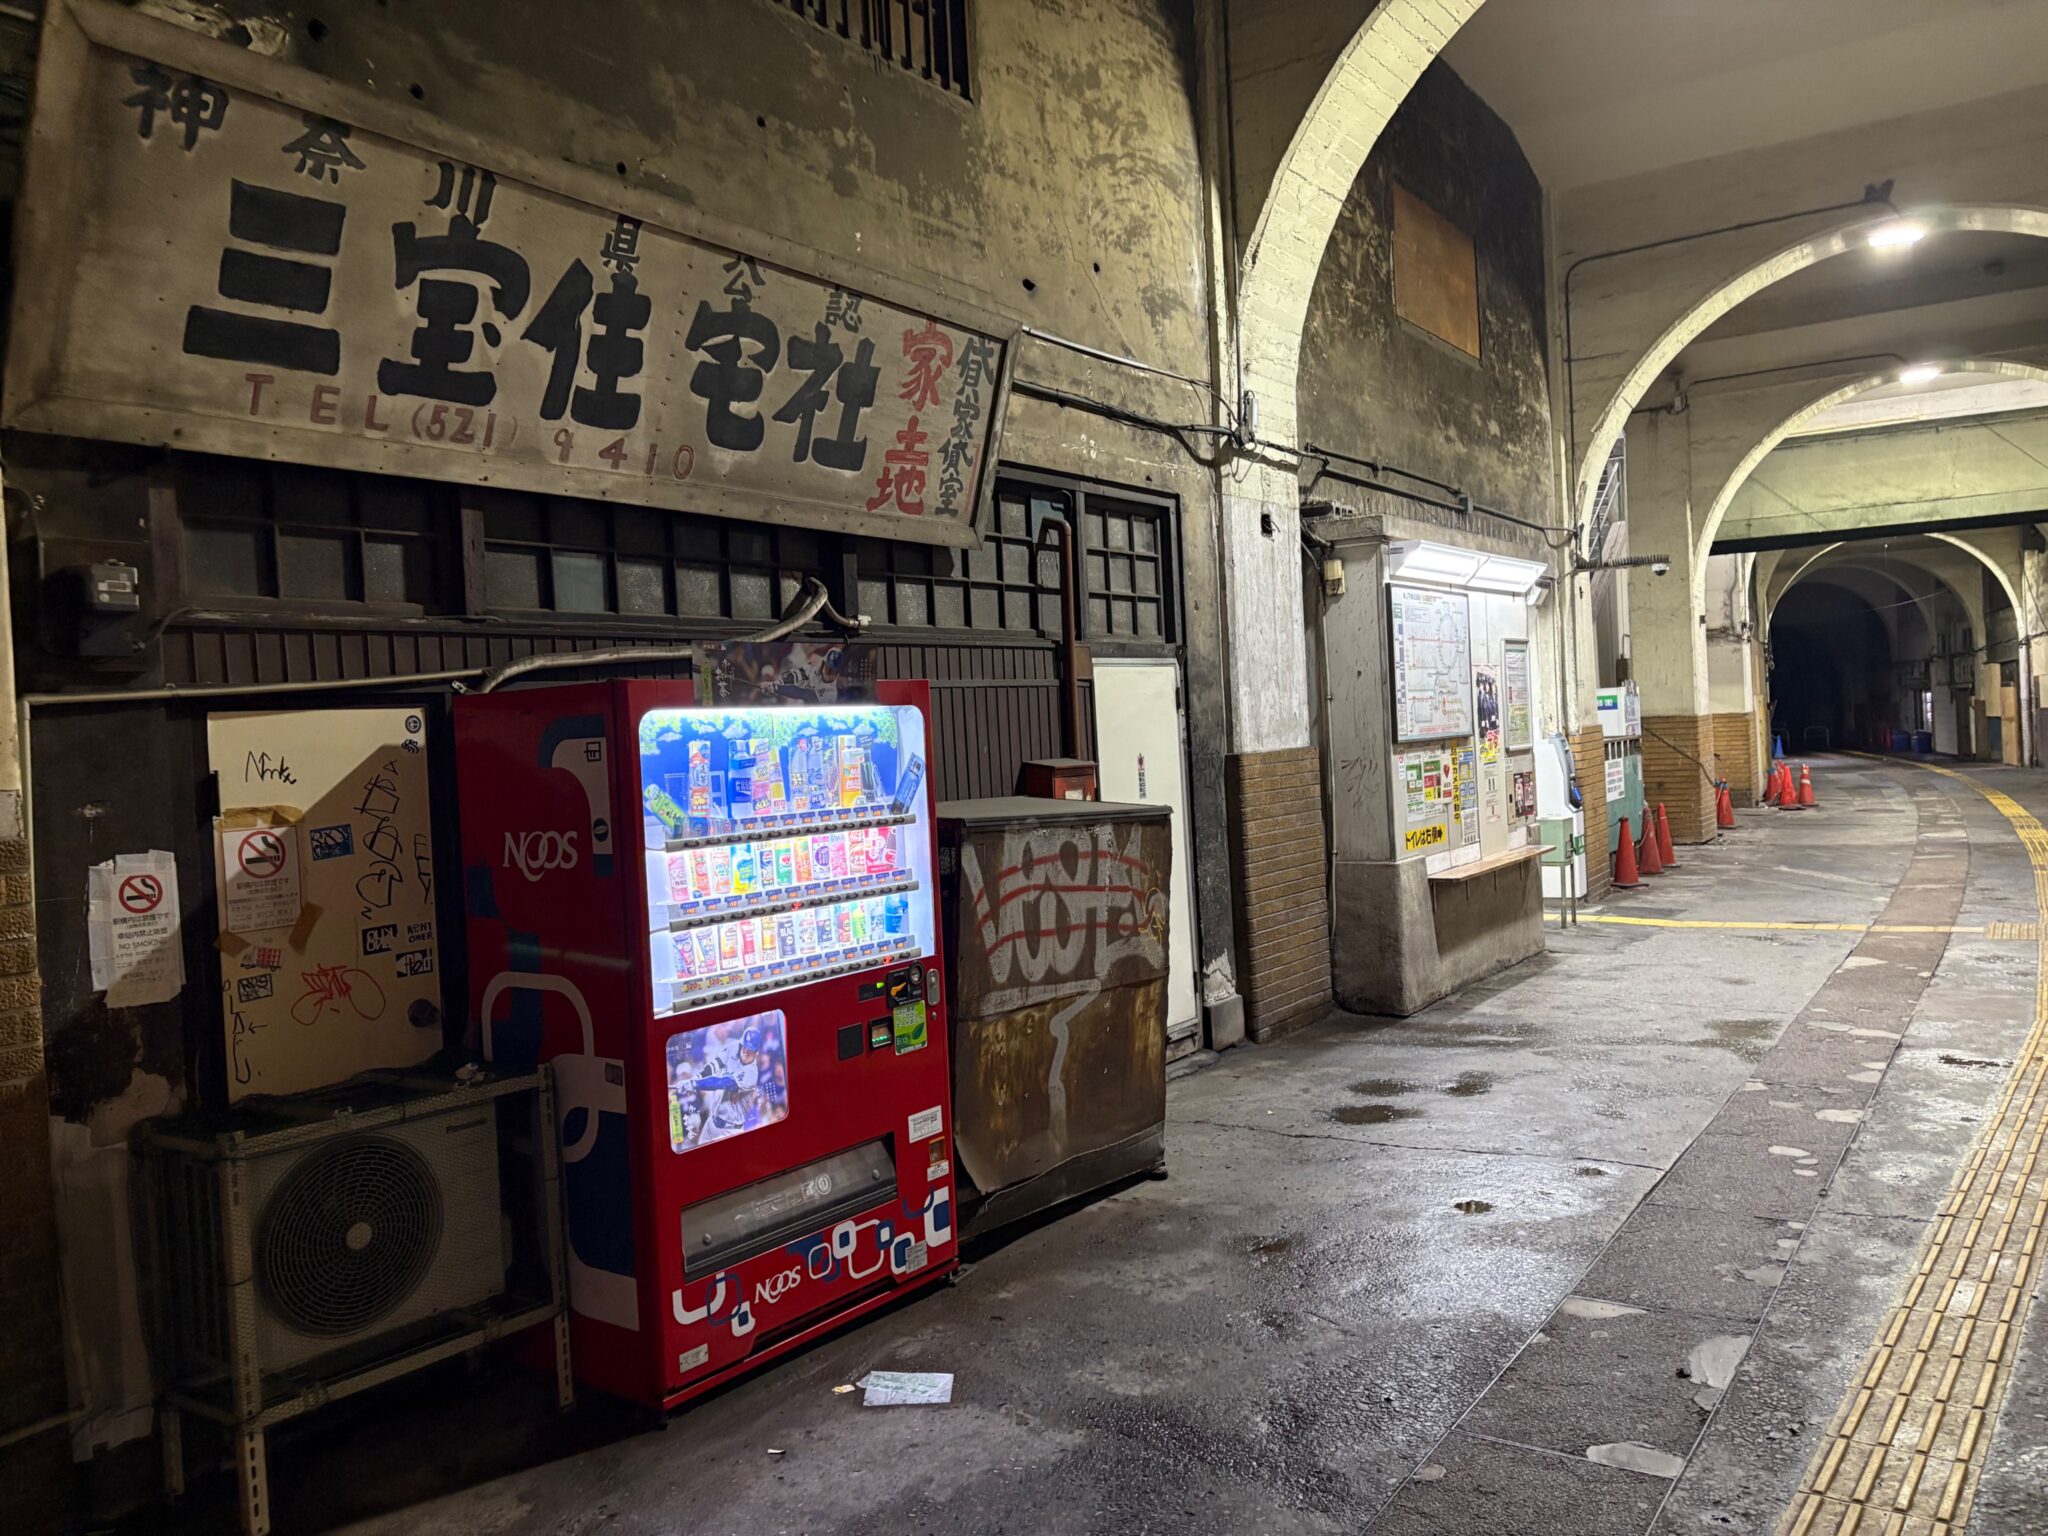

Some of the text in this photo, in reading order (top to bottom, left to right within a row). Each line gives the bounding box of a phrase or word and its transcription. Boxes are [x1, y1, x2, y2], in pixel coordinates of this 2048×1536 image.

[182, 176, 882, 472] 三宝住宅社
[245, 373, 390, 432] TEL
[553, 428, 695, 480] 9410
